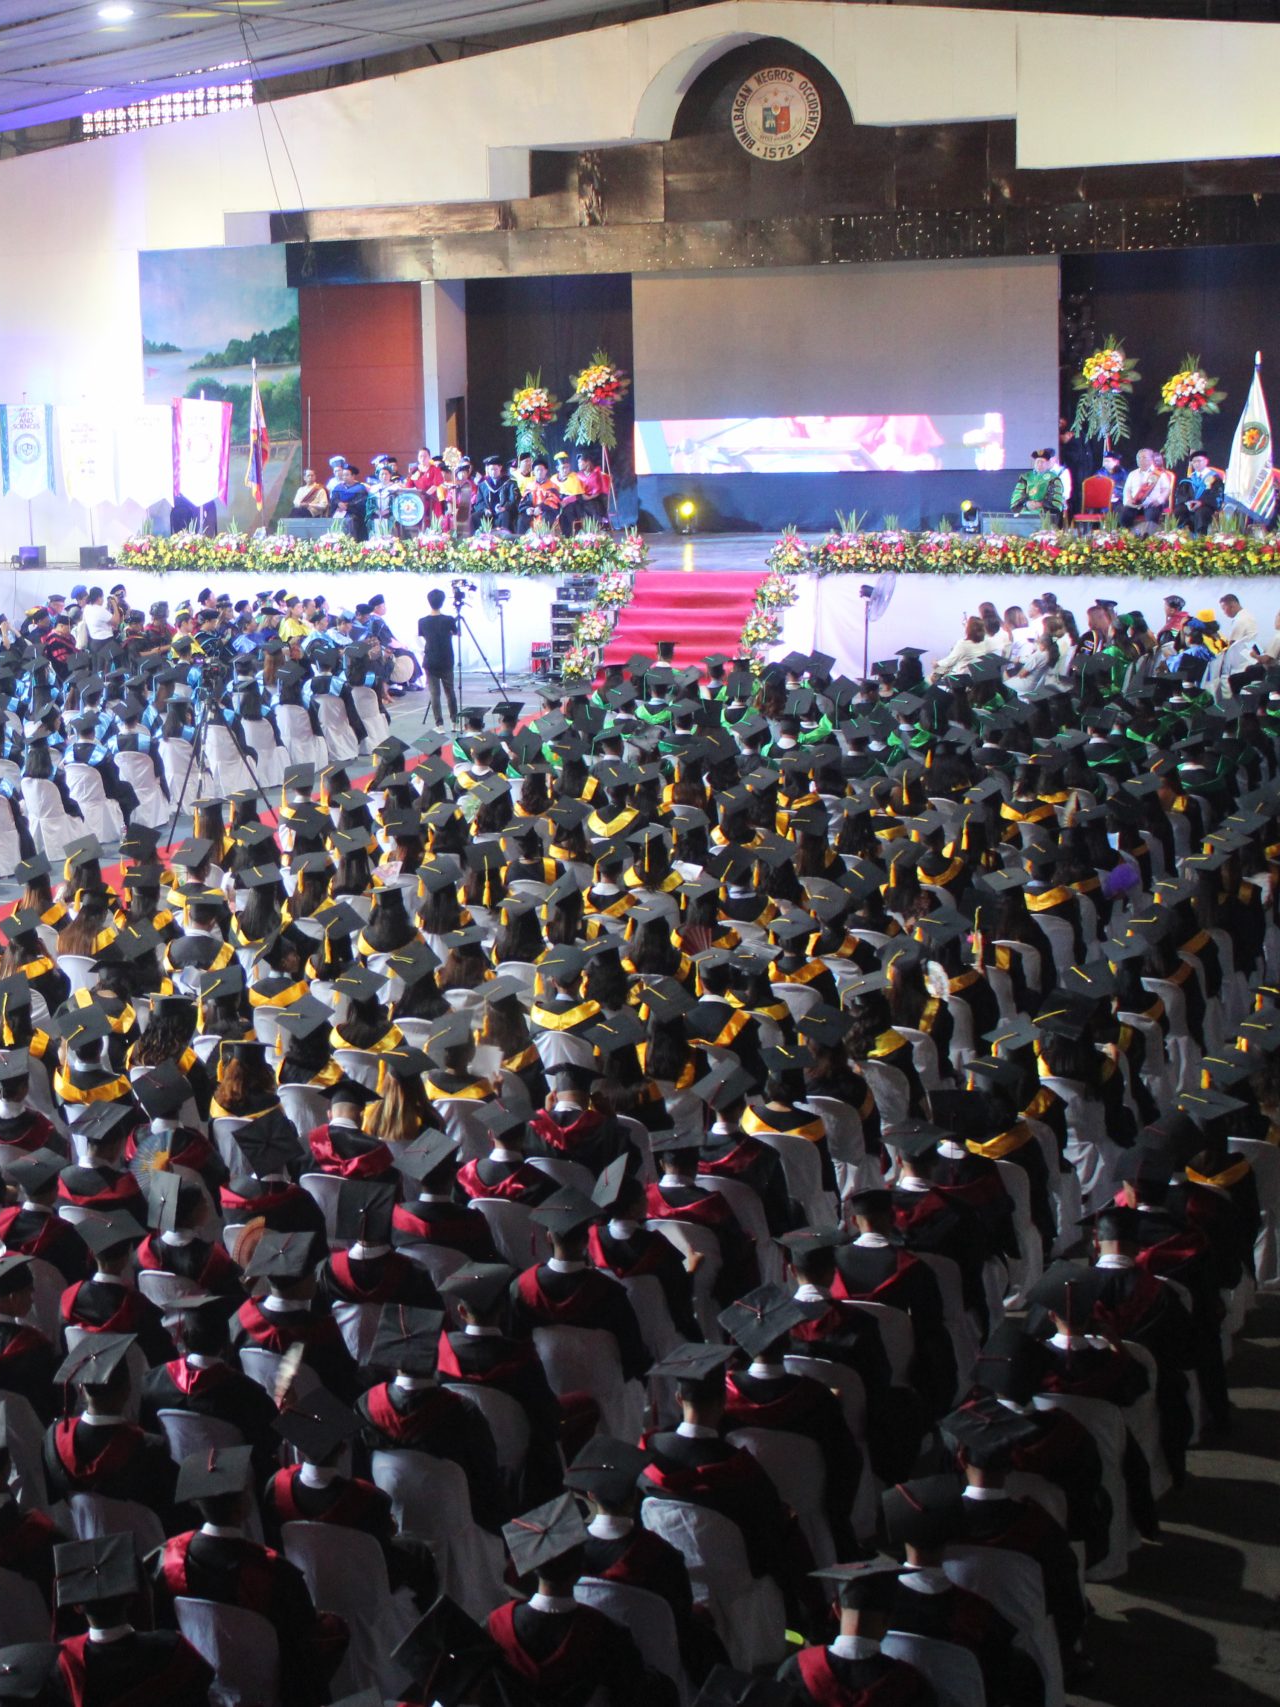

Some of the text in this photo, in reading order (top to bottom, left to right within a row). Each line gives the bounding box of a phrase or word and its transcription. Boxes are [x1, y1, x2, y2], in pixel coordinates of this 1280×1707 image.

[733, 69, 819, 149] BINALBAGAN NEGROS OCCIDENTAL
[763, 144, 795, 158] 1572
